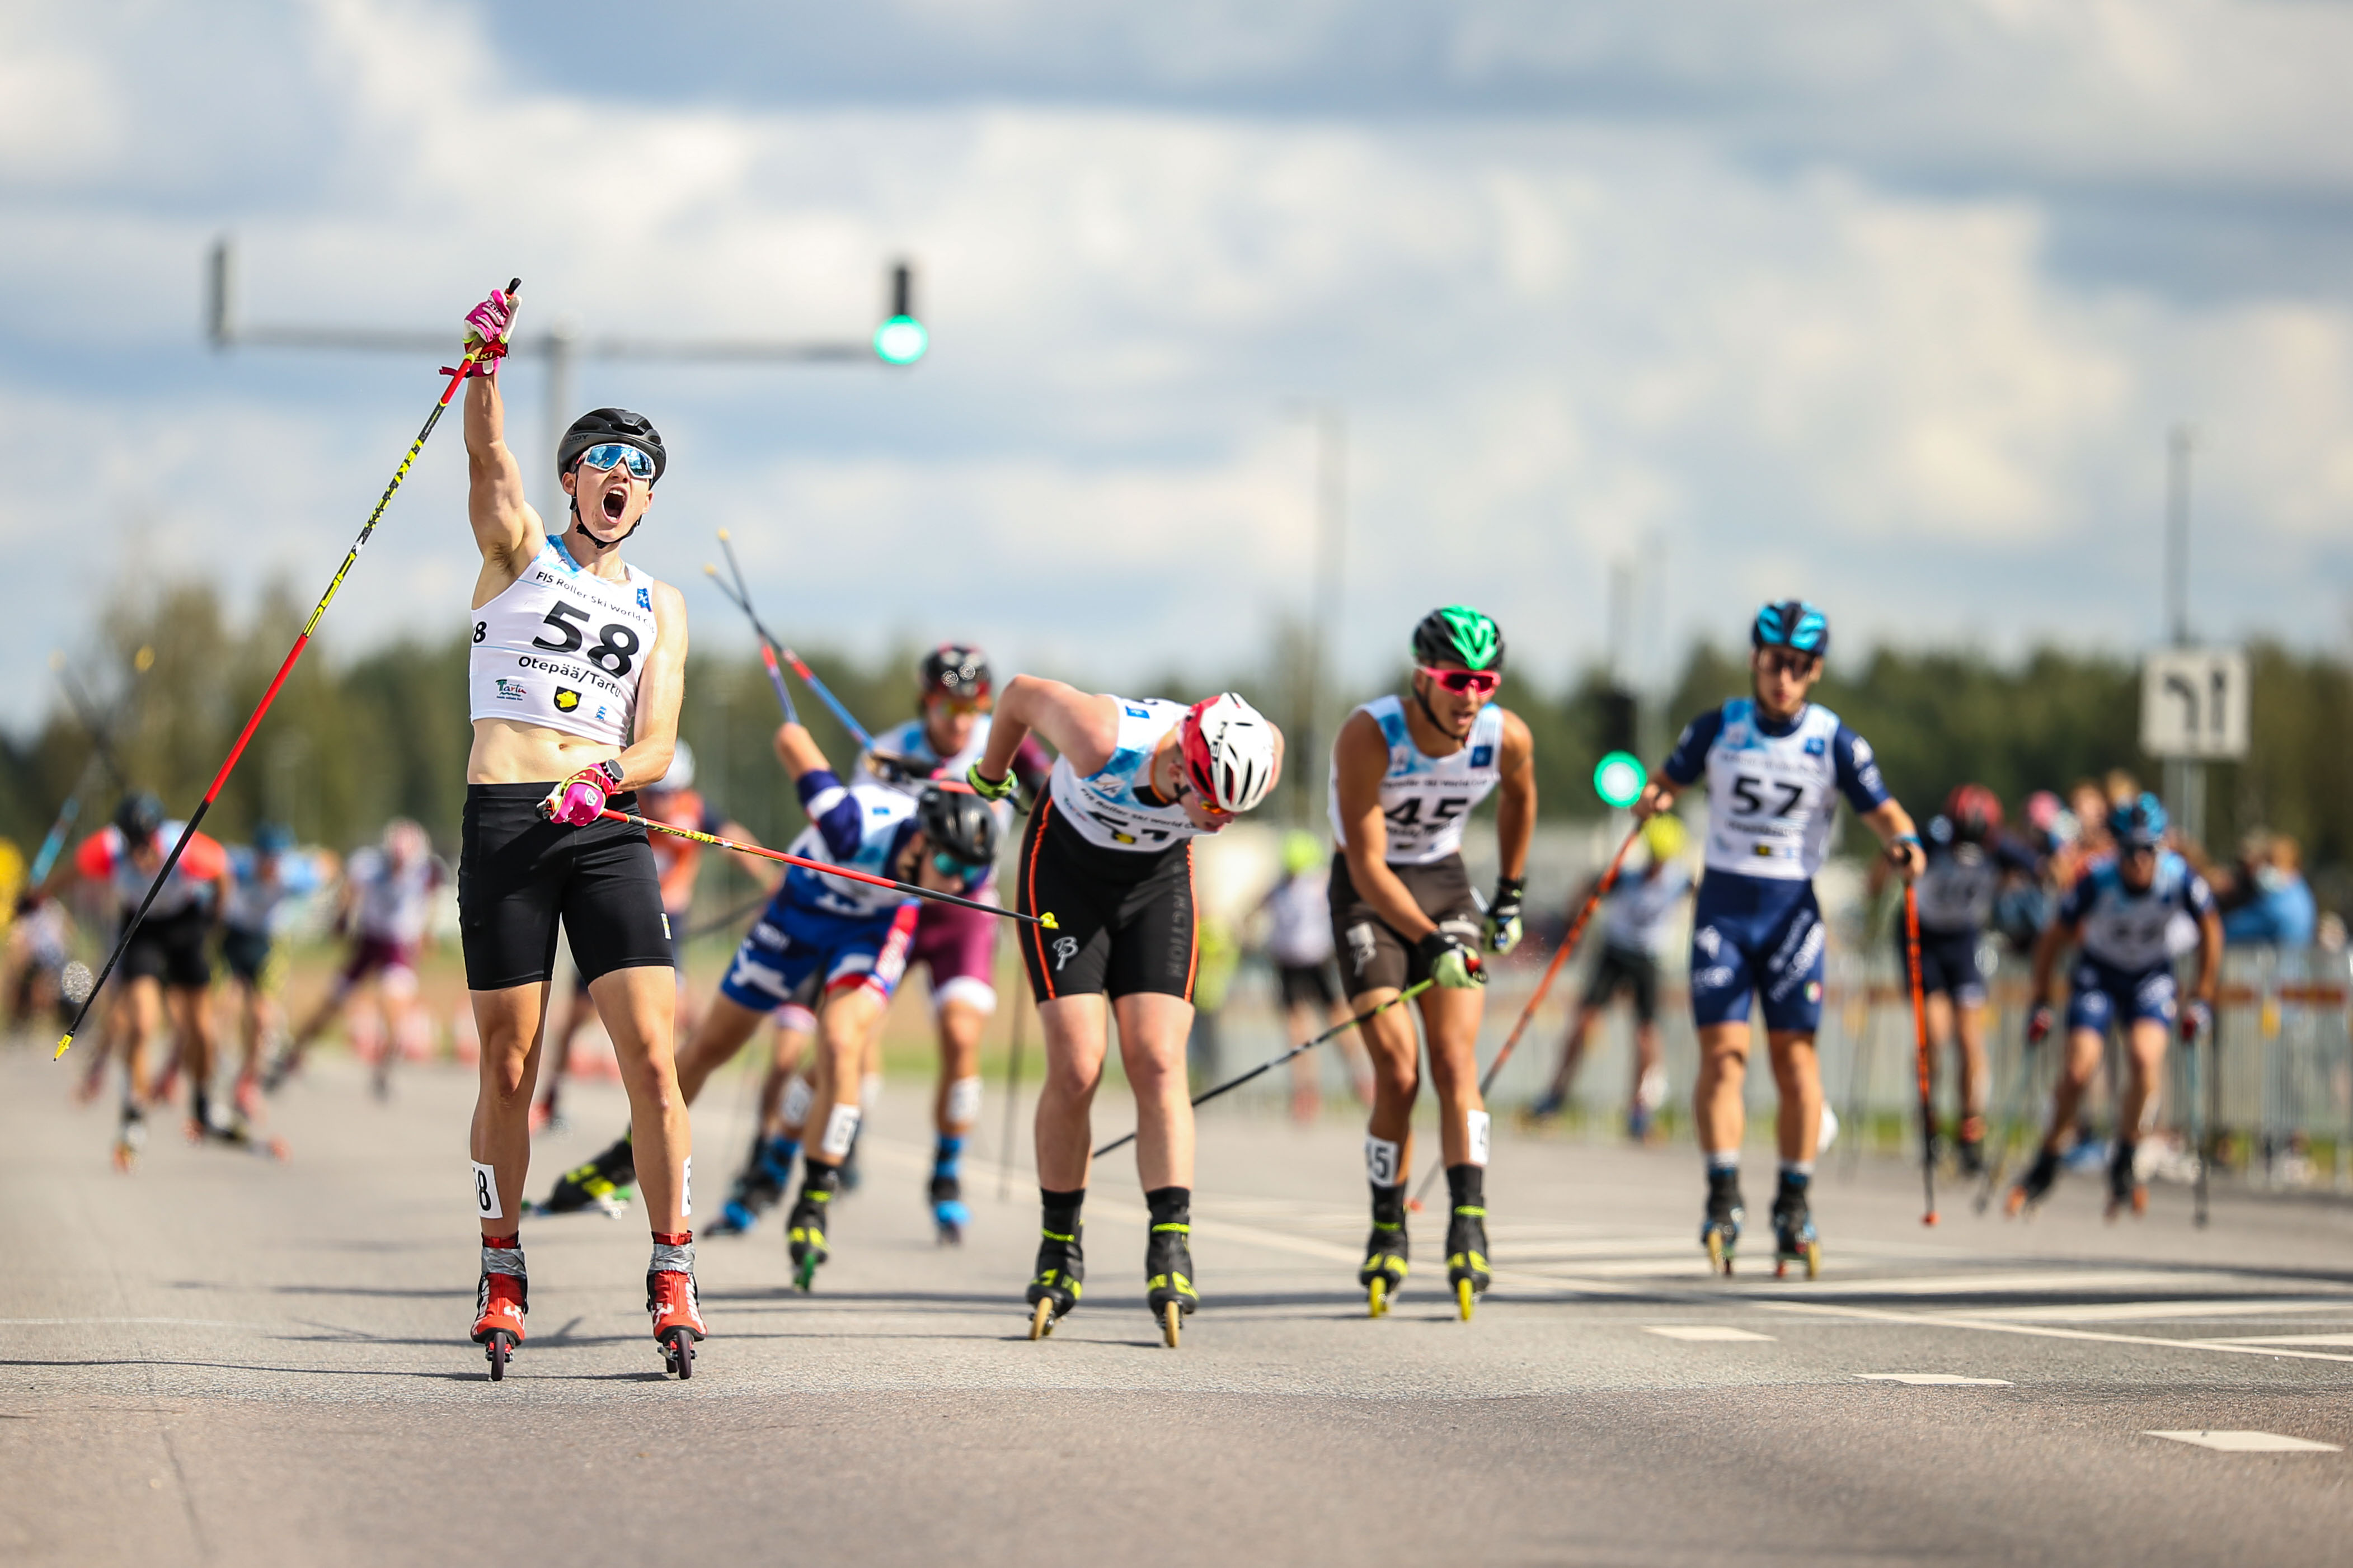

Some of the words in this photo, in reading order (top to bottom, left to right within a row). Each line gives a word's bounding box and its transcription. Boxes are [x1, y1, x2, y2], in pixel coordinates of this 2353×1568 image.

[394, 438, 423, 484] LEKI
[536, 571, 554, 583] FIS
[556, 578, 587, 599] Roller
[591, 596, 607, 607] Ski
[610, 604, 641, 621] World
[473, 621, 487, 643] 8
[532, 600, 640, 679] 58
[495, 679, 527, 694] Tartu
[518, 656, 621, 698] Otepää/Tartu
[1384, 797, 1468, 829] 45
[1731, 775, 1804, 817] 57
[472, 1166, 492, 1212] 8
